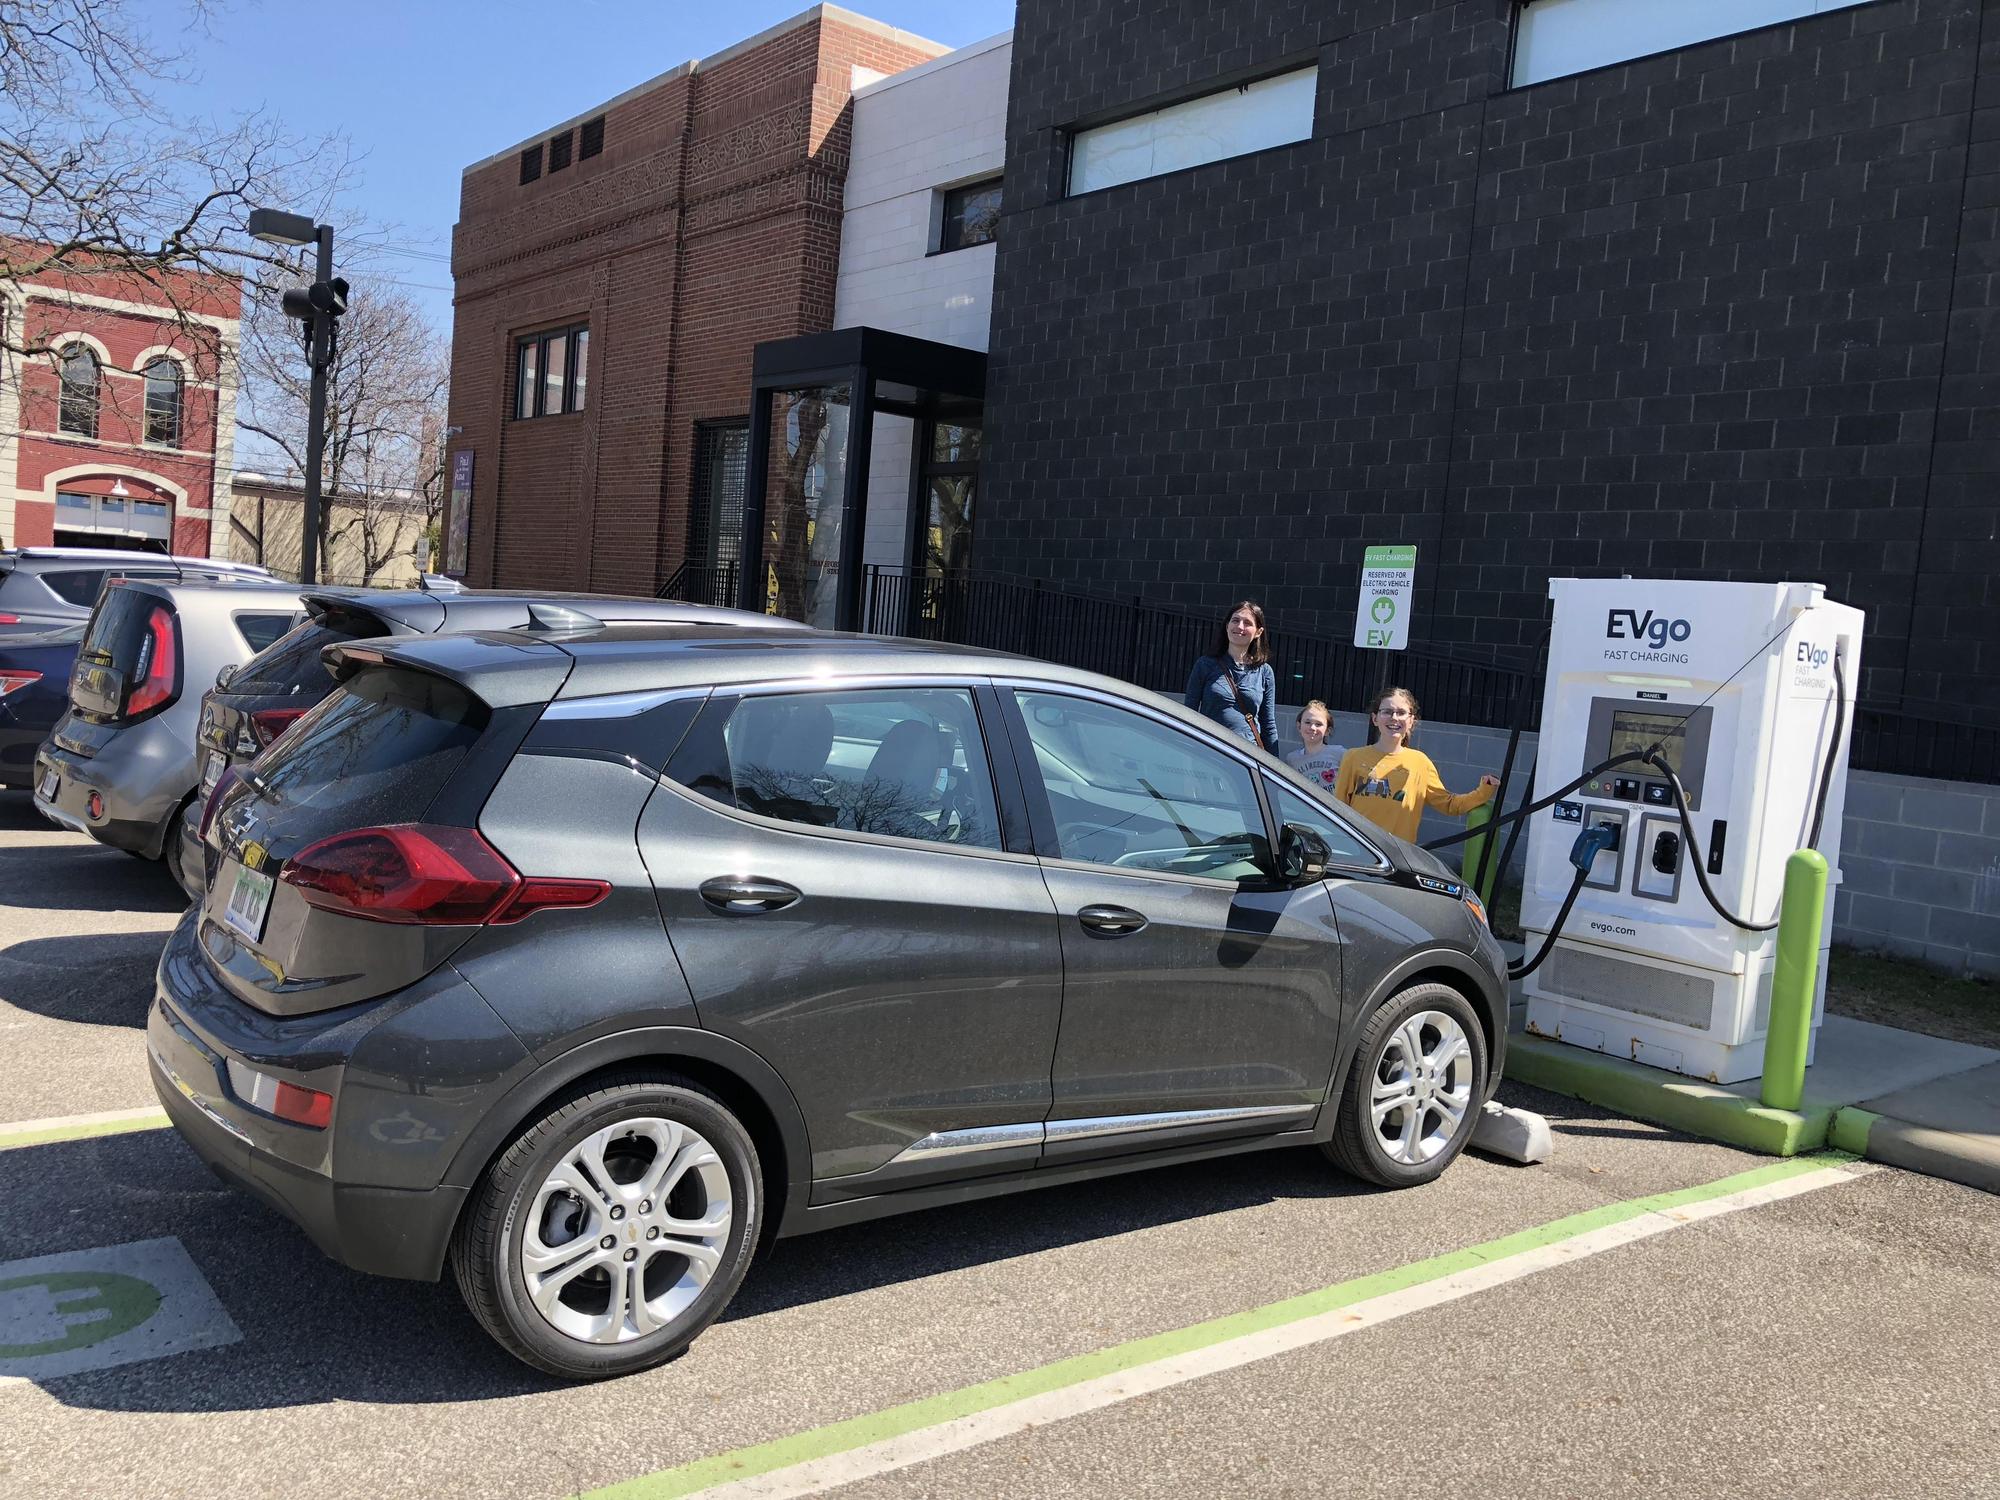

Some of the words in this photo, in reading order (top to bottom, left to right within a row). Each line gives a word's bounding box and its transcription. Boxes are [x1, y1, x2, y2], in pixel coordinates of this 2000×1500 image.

[1368, 571, 1395, 579] RESERVED
[1396, 571, 1407, 579] FOR
[1363, 579, 1387, 587] ELECTRIC
[1388, 580, 1410, 588] VEHICLE
[1372, 588, 1398, 596] CHARGING
[1607, 608, 1691, 649] EVgo
[1367, 629, 1394, 647] EV
[1604, 650, 1628, 660] FAST
[1630, 651, 1688, 664] CHARGING
[1797, 641, 1828, 669] EVgo
[1590, 921, 1636, 936] evgo.com
